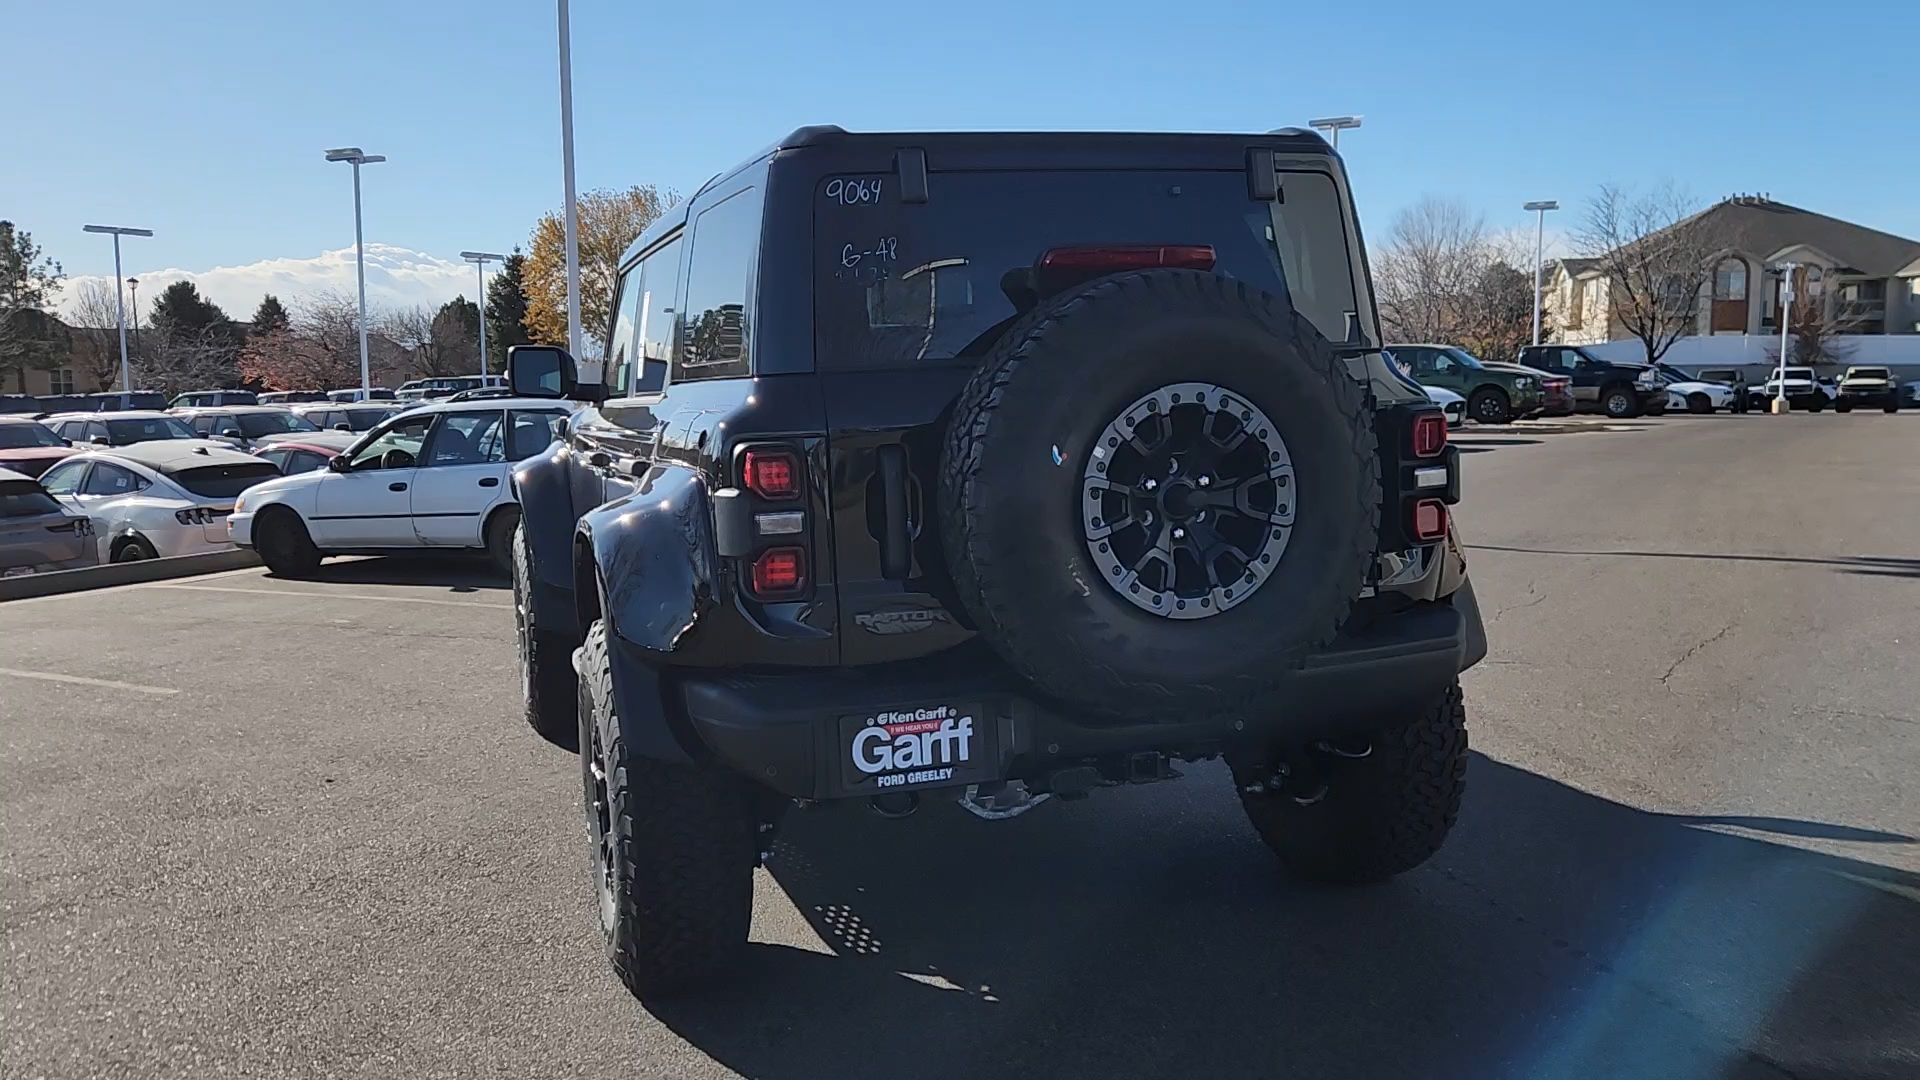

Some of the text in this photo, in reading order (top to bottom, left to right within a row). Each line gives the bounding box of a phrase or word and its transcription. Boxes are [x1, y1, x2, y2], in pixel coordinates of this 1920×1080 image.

[826, 179, 882, 205] 9064
[855, 609, 951, 627] RAPTOR
[889, 706, 948, 724] Ken Garff
[895, 722, 934, 733] WE HEAR YOU
[852, 716, 973, 773] Garff
[877, 768, 953, 788] FORD GREELEY
